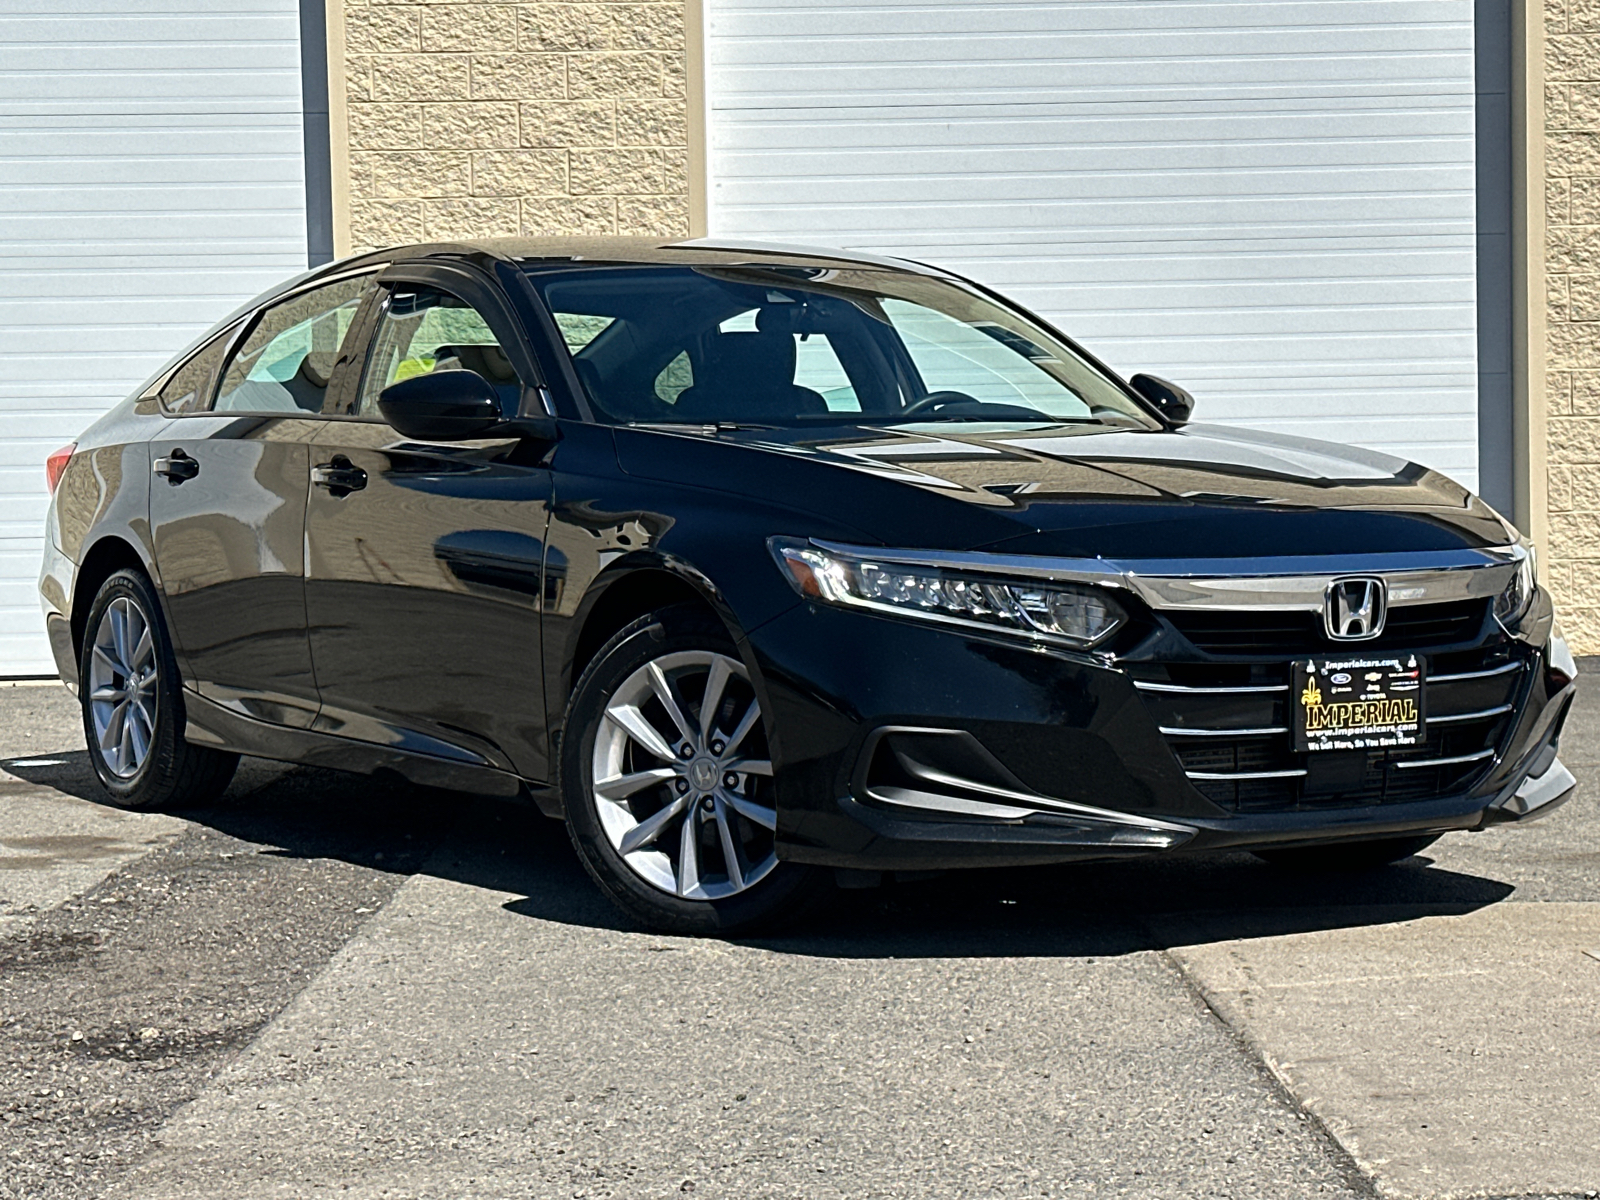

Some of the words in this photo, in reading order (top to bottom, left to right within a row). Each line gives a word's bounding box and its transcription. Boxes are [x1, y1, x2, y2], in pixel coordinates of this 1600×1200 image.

[1306, 699, 1418, 729] IMPERIAL
[1307, 742, 1319, 751] We
[1354, 739, 1364, 748] So
[1366, 738, 1378, 747] You
